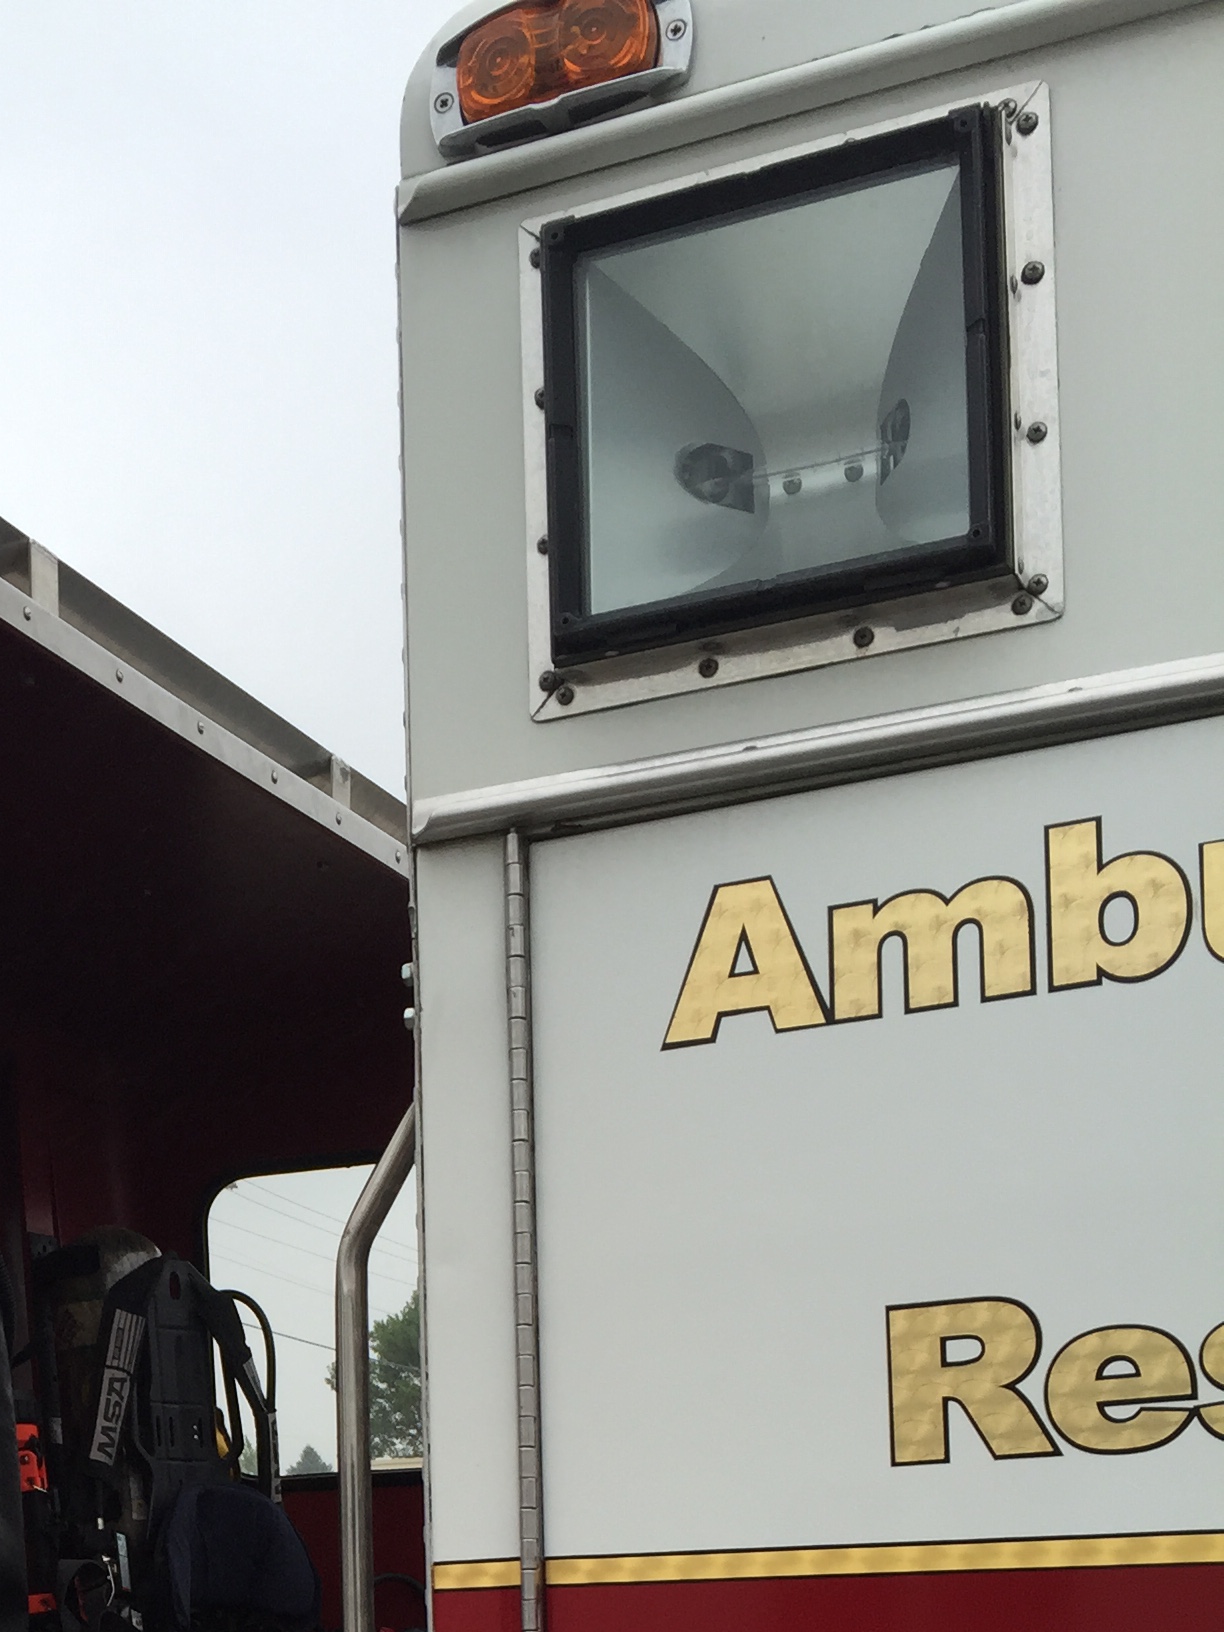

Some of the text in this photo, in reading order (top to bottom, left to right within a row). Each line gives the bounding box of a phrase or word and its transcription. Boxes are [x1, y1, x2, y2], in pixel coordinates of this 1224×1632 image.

[661, 816, 1224, 1051] Amb
[97, 1377, 127, 1459] MSA
[885, 1296, 1224, 1467] Re
